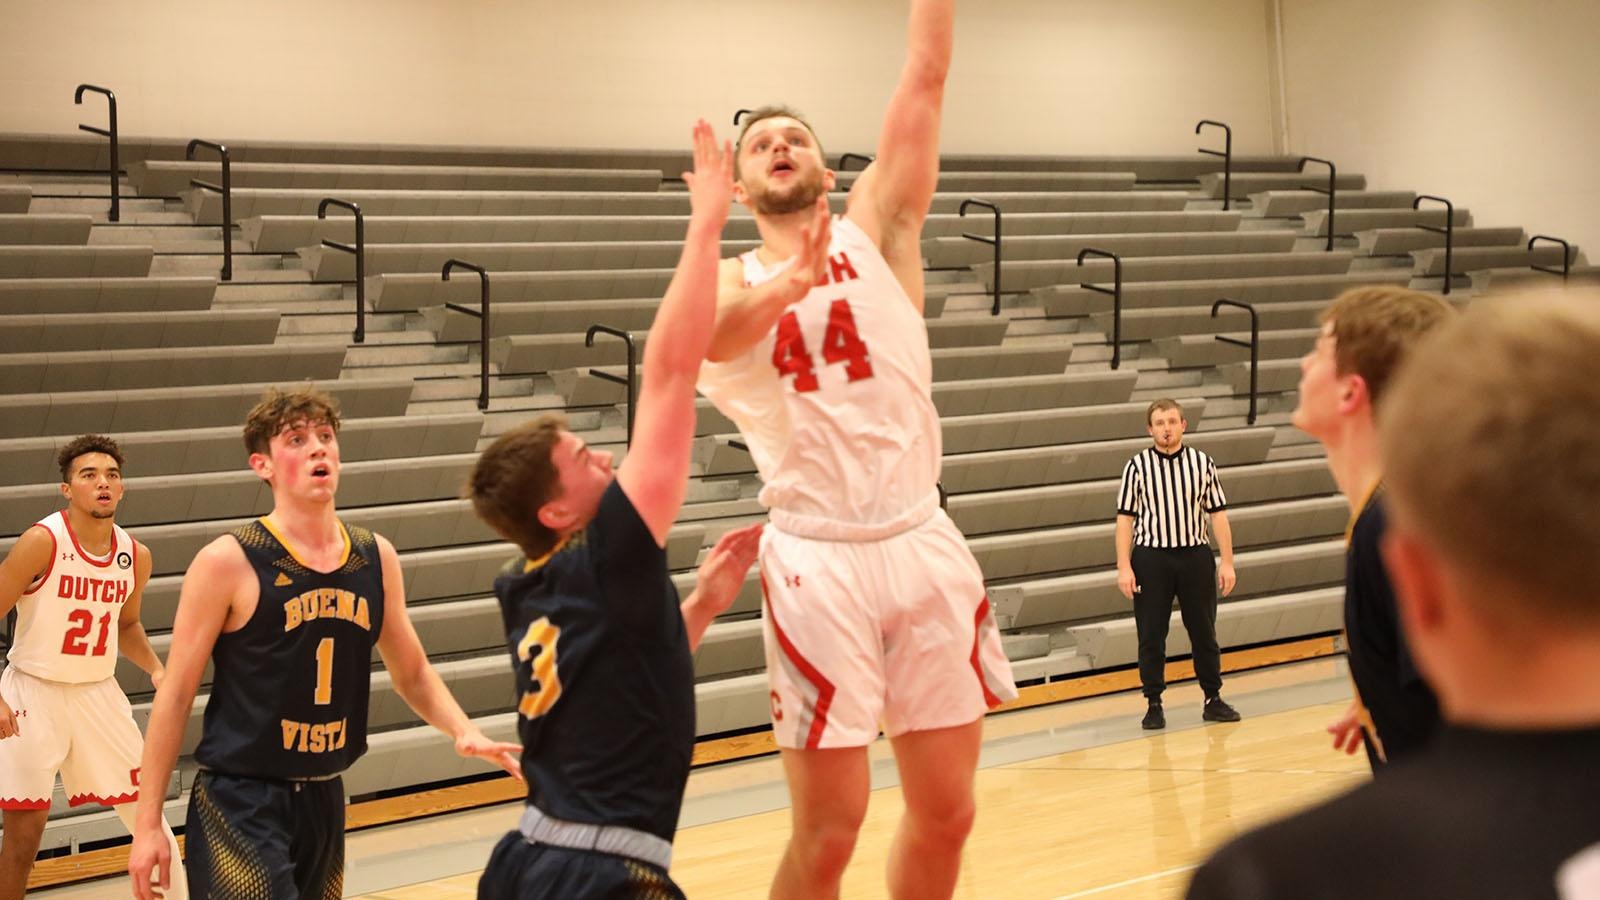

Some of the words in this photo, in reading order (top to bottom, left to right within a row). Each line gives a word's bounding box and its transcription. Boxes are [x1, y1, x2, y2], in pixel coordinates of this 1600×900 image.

[772, 299, 874, 393] 44
[58, 574, 128, 603] DUTCH
[284, 588, 371, 632] BUENA
[61, 609, 111, 656] 21
[314, 638, 334, 705] 1
[518, 616, 562, 720] 3
